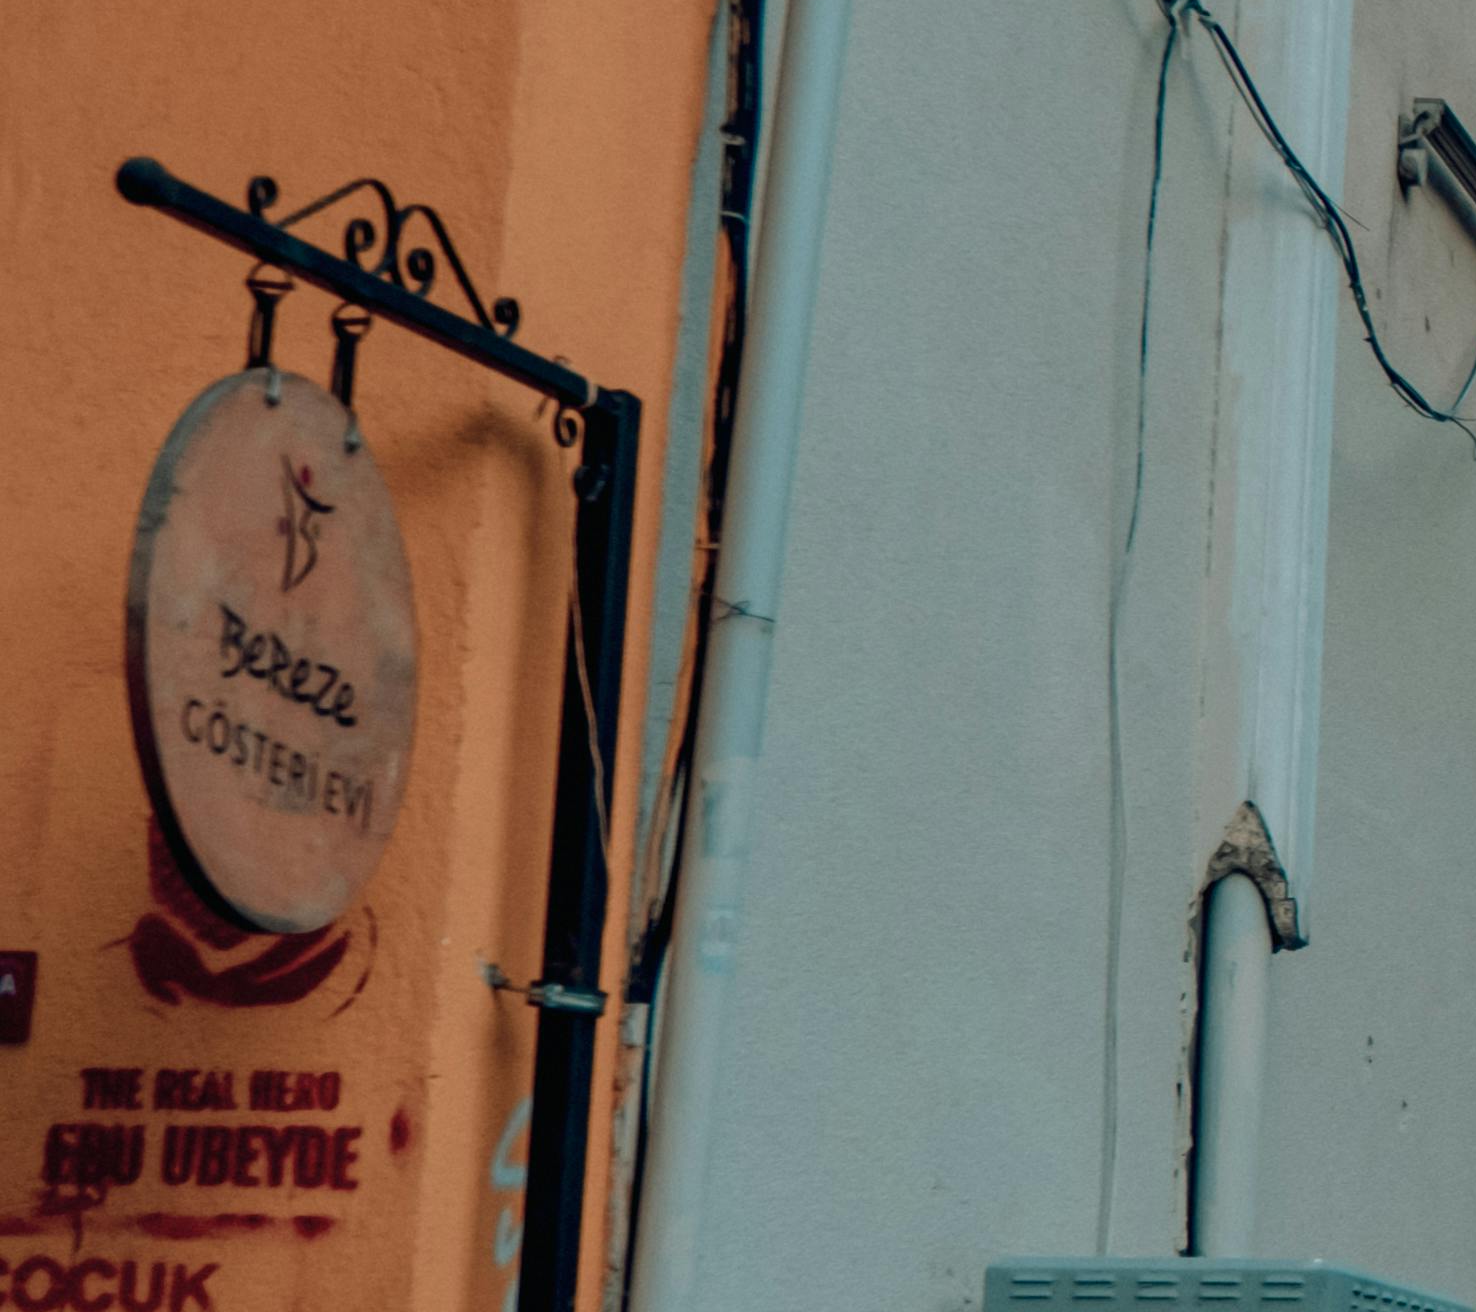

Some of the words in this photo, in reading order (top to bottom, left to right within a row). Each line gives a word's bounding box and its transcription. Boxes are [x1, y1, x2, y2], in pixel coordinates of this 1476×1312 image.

[80, 1067, 144, 1110] THE
[153, 1068, 237, 1111] REAL
[250, 1070, 342, 1112] HERO
[43, 1122, 146, 1187] EBU
[161, 1124, 363, 1190] UBEYDE
